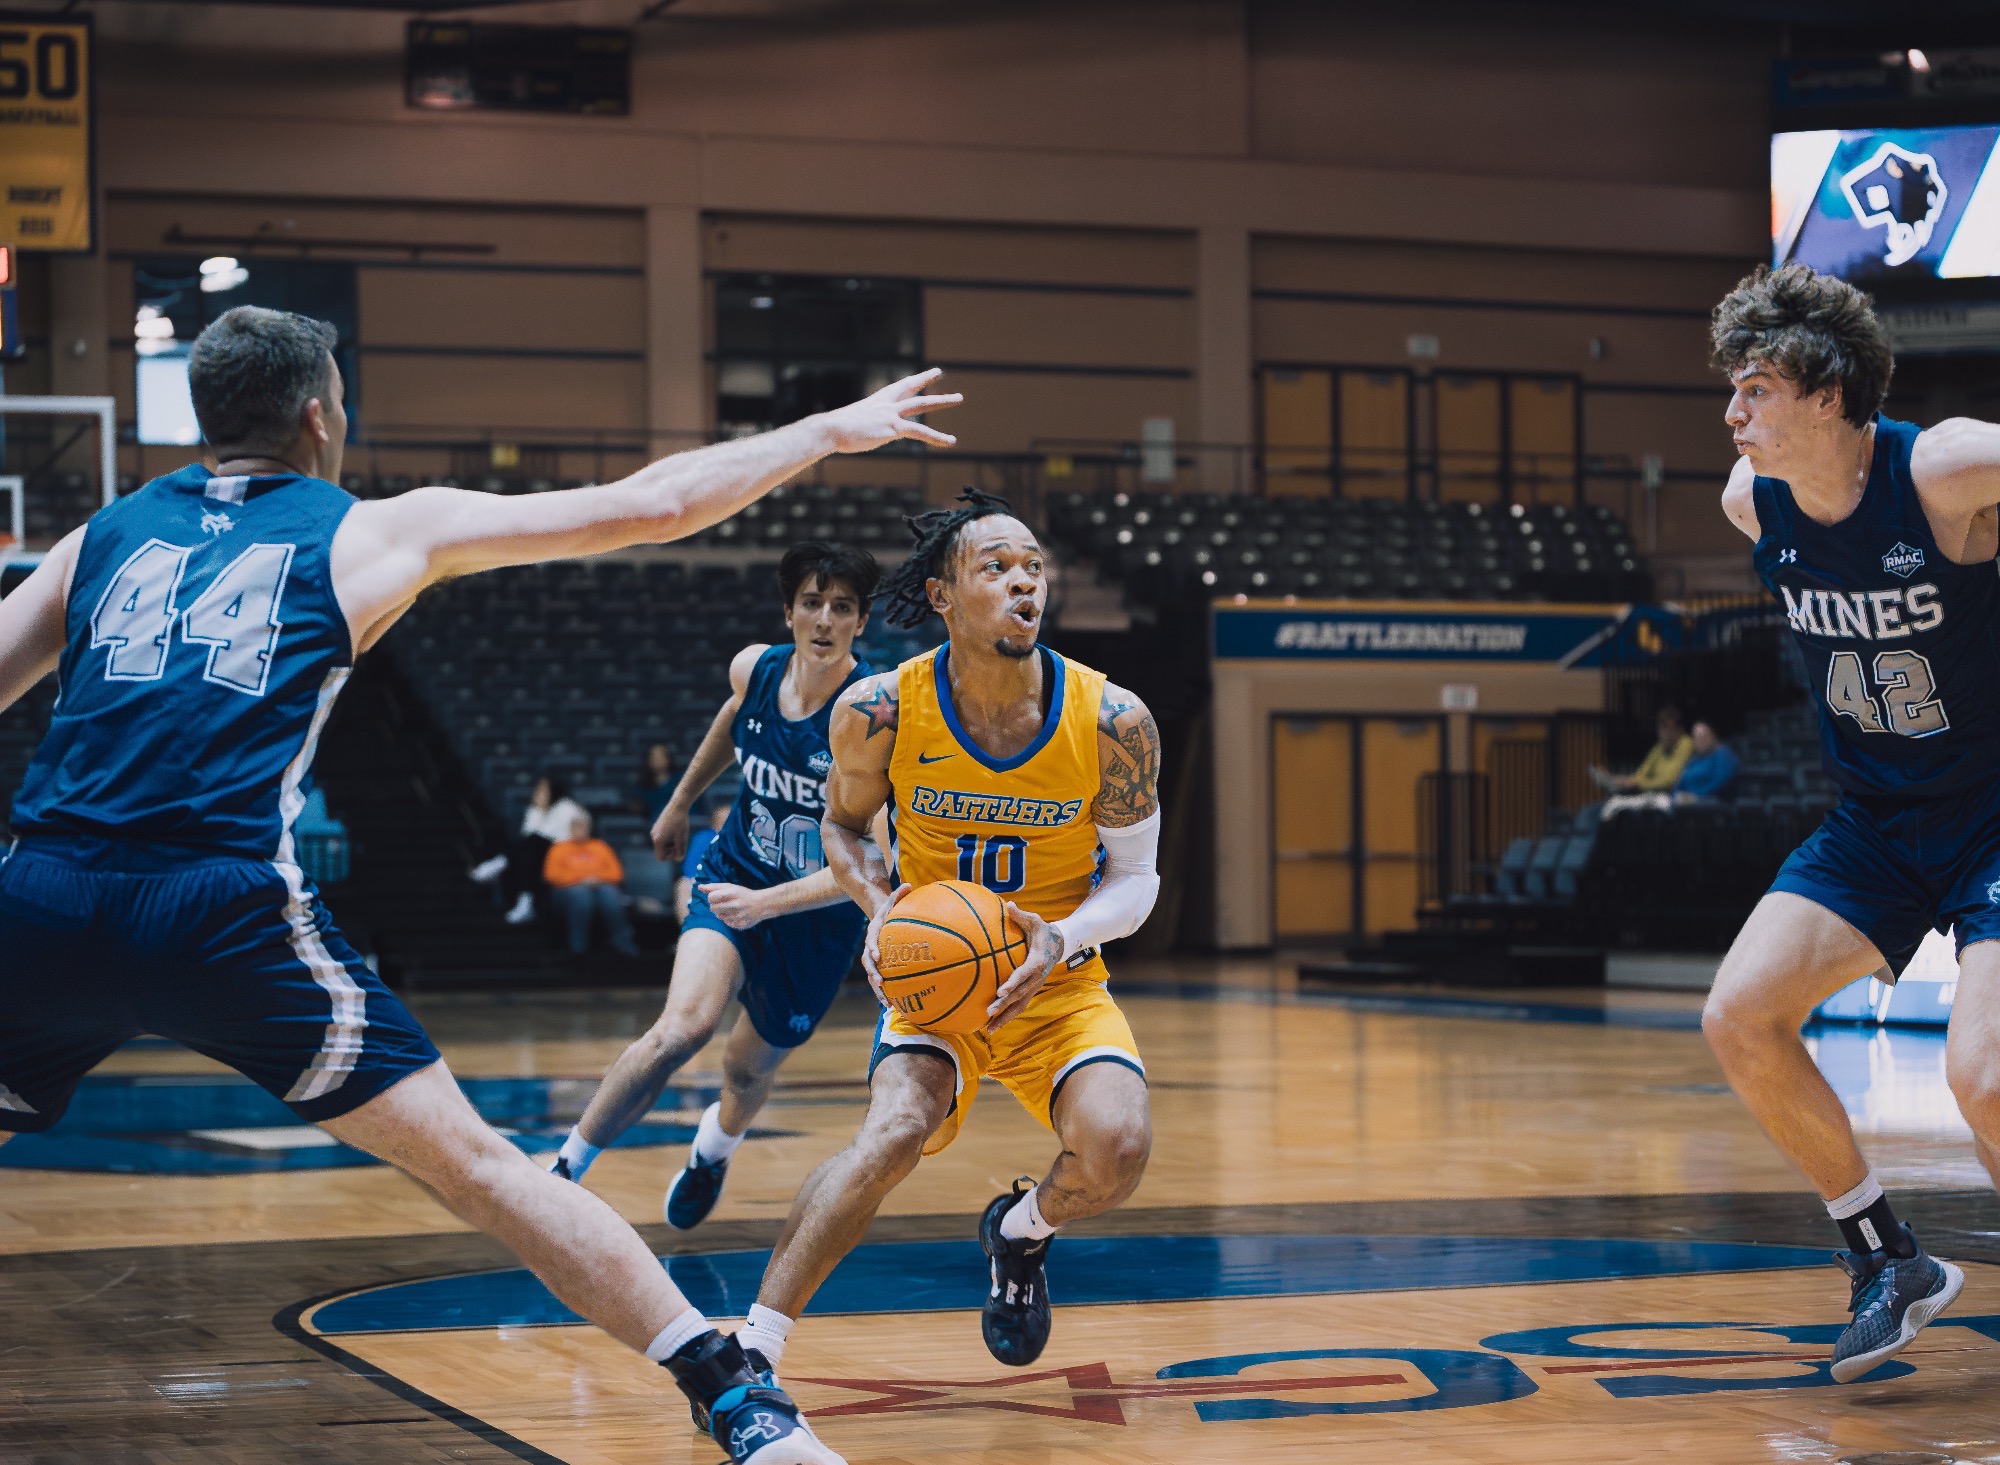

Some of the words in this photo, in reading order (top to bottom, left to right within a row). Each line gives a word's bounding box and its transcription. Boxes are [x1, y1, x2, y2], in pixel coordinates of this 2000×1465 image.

[0, 32, 78, 99] 50
[1886, 552, 1921, 568] RMAC
[90, 538, 296, 696] 44
[1274, 622, 1526, 651] #RATTLERNATION
[1780, 582, 1944, 640] MINES
[1826, 650, 1950, 739] 42
[911, 785, 1084, 827] RATTLERS
[748, 799, 824, 880] 20
[955, 833, 1030, 893] 10
